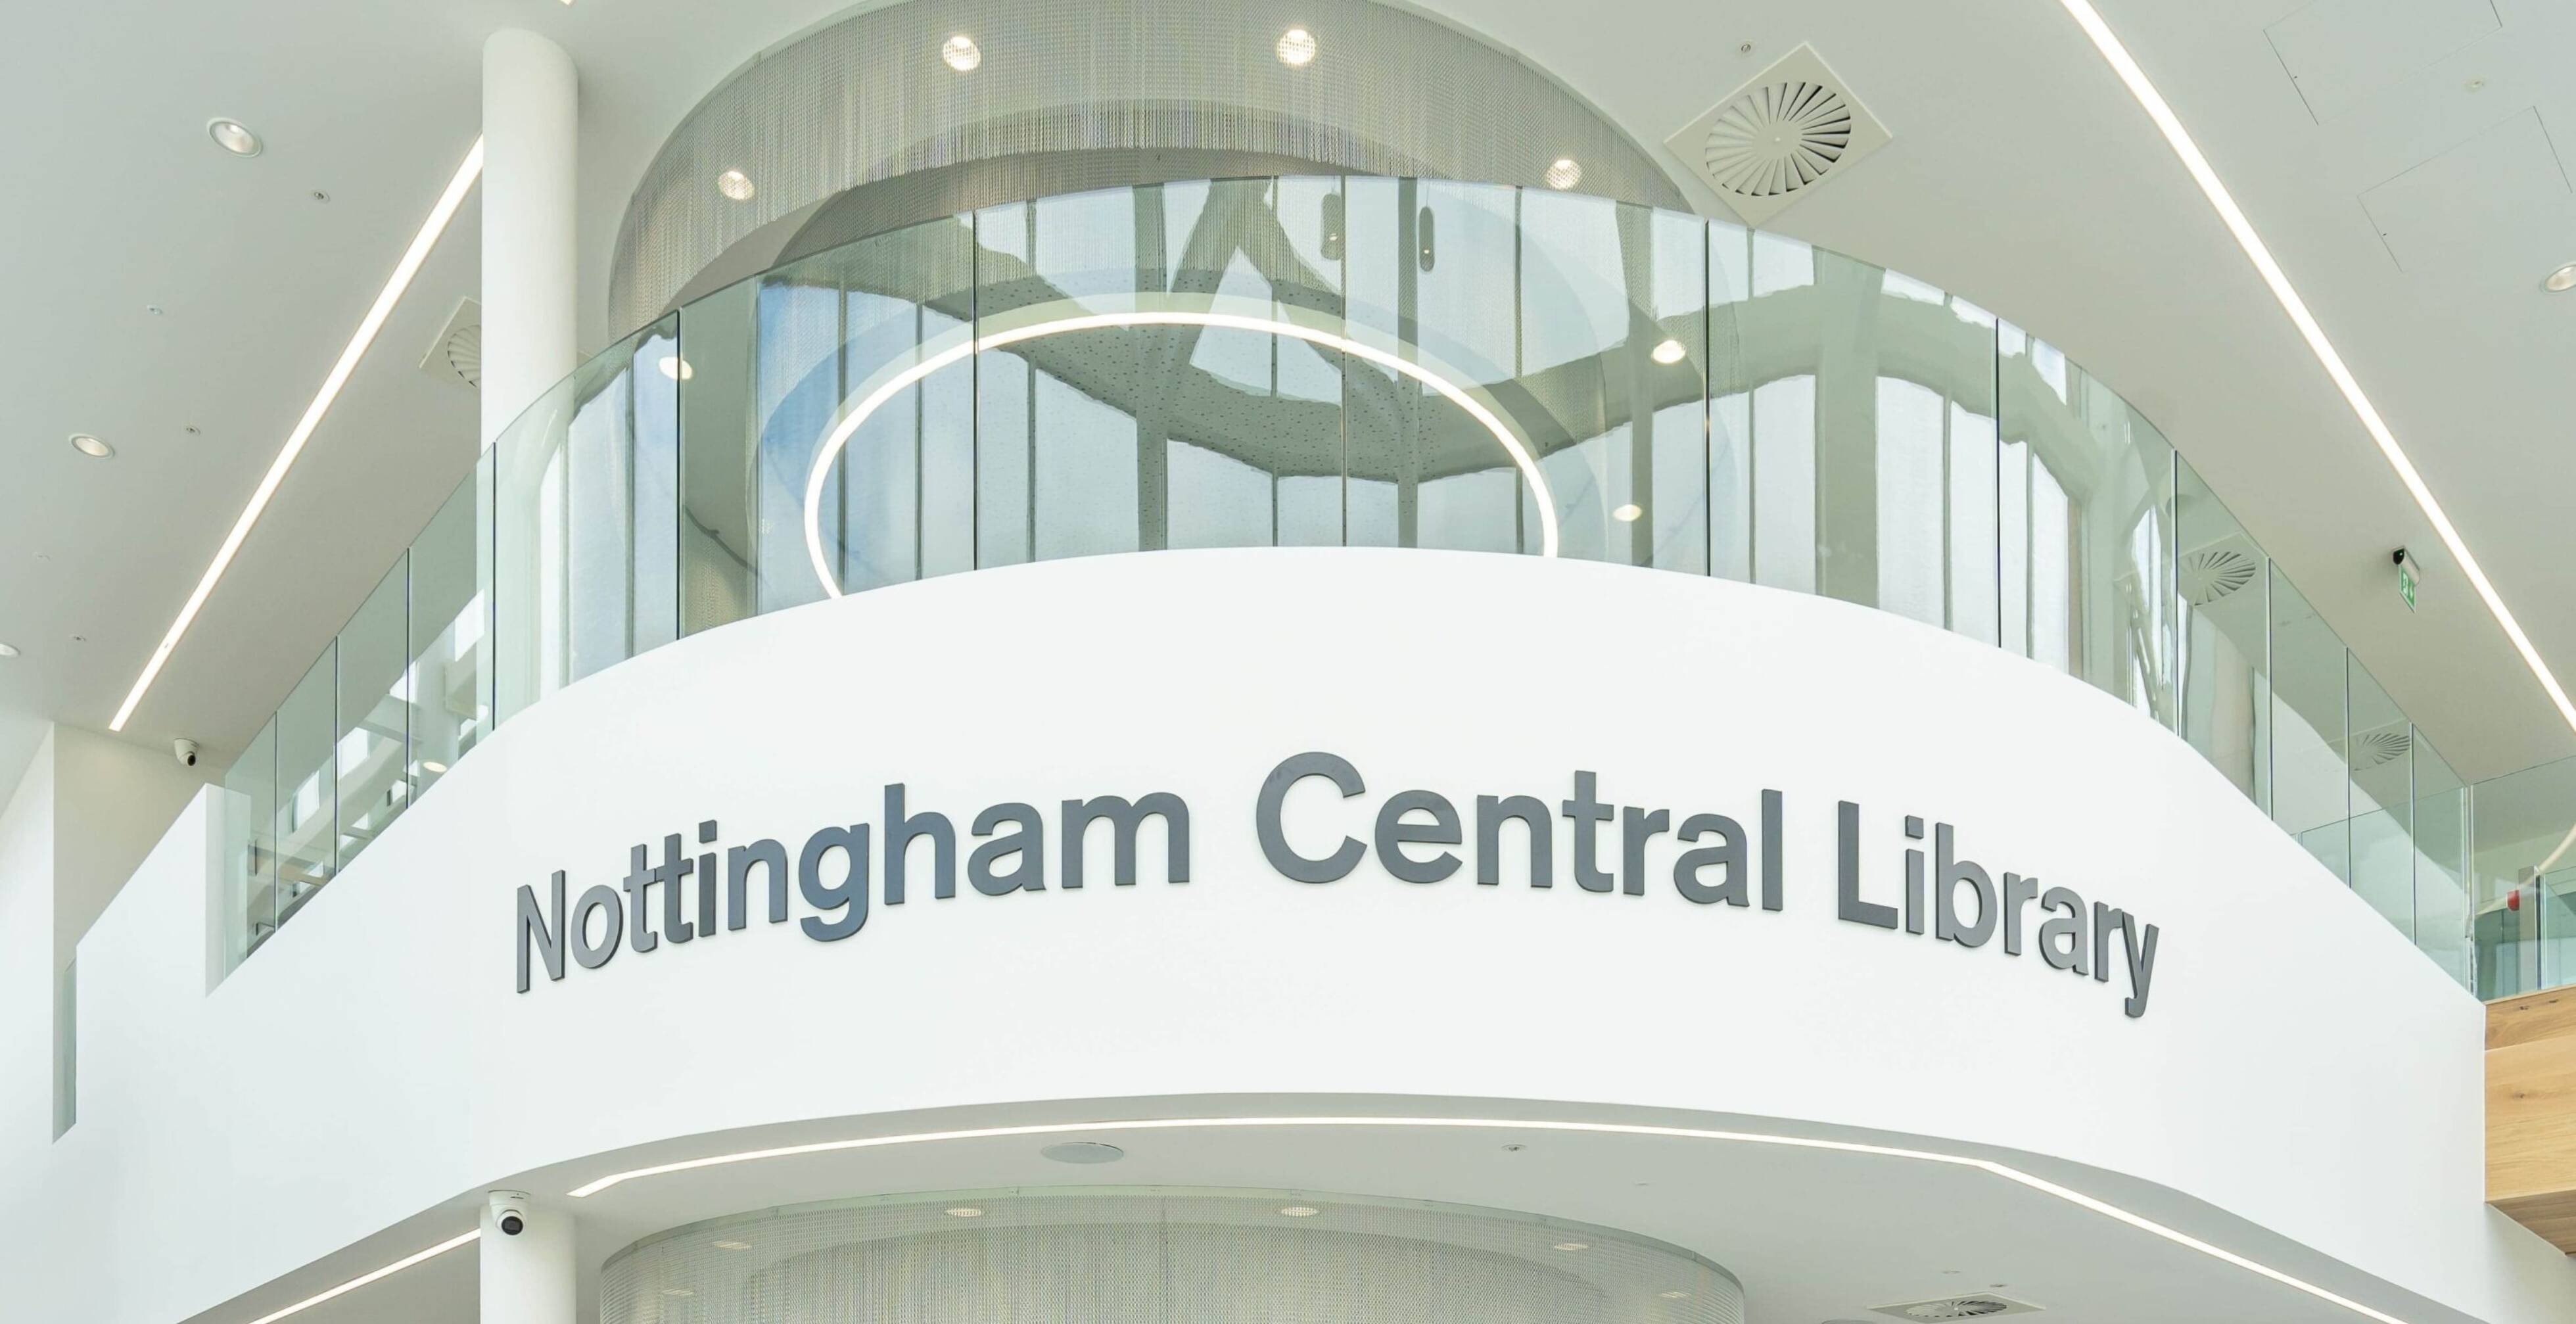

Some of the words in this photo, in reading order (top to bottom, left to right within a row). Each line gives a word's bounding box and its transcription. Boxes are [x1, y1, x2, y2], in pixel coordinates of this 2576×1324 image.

[516, 782, 1190, 995] Nottingham
[1255, 751, 1783, 912] Central
[1837, 800, 2160, 1020] Library
